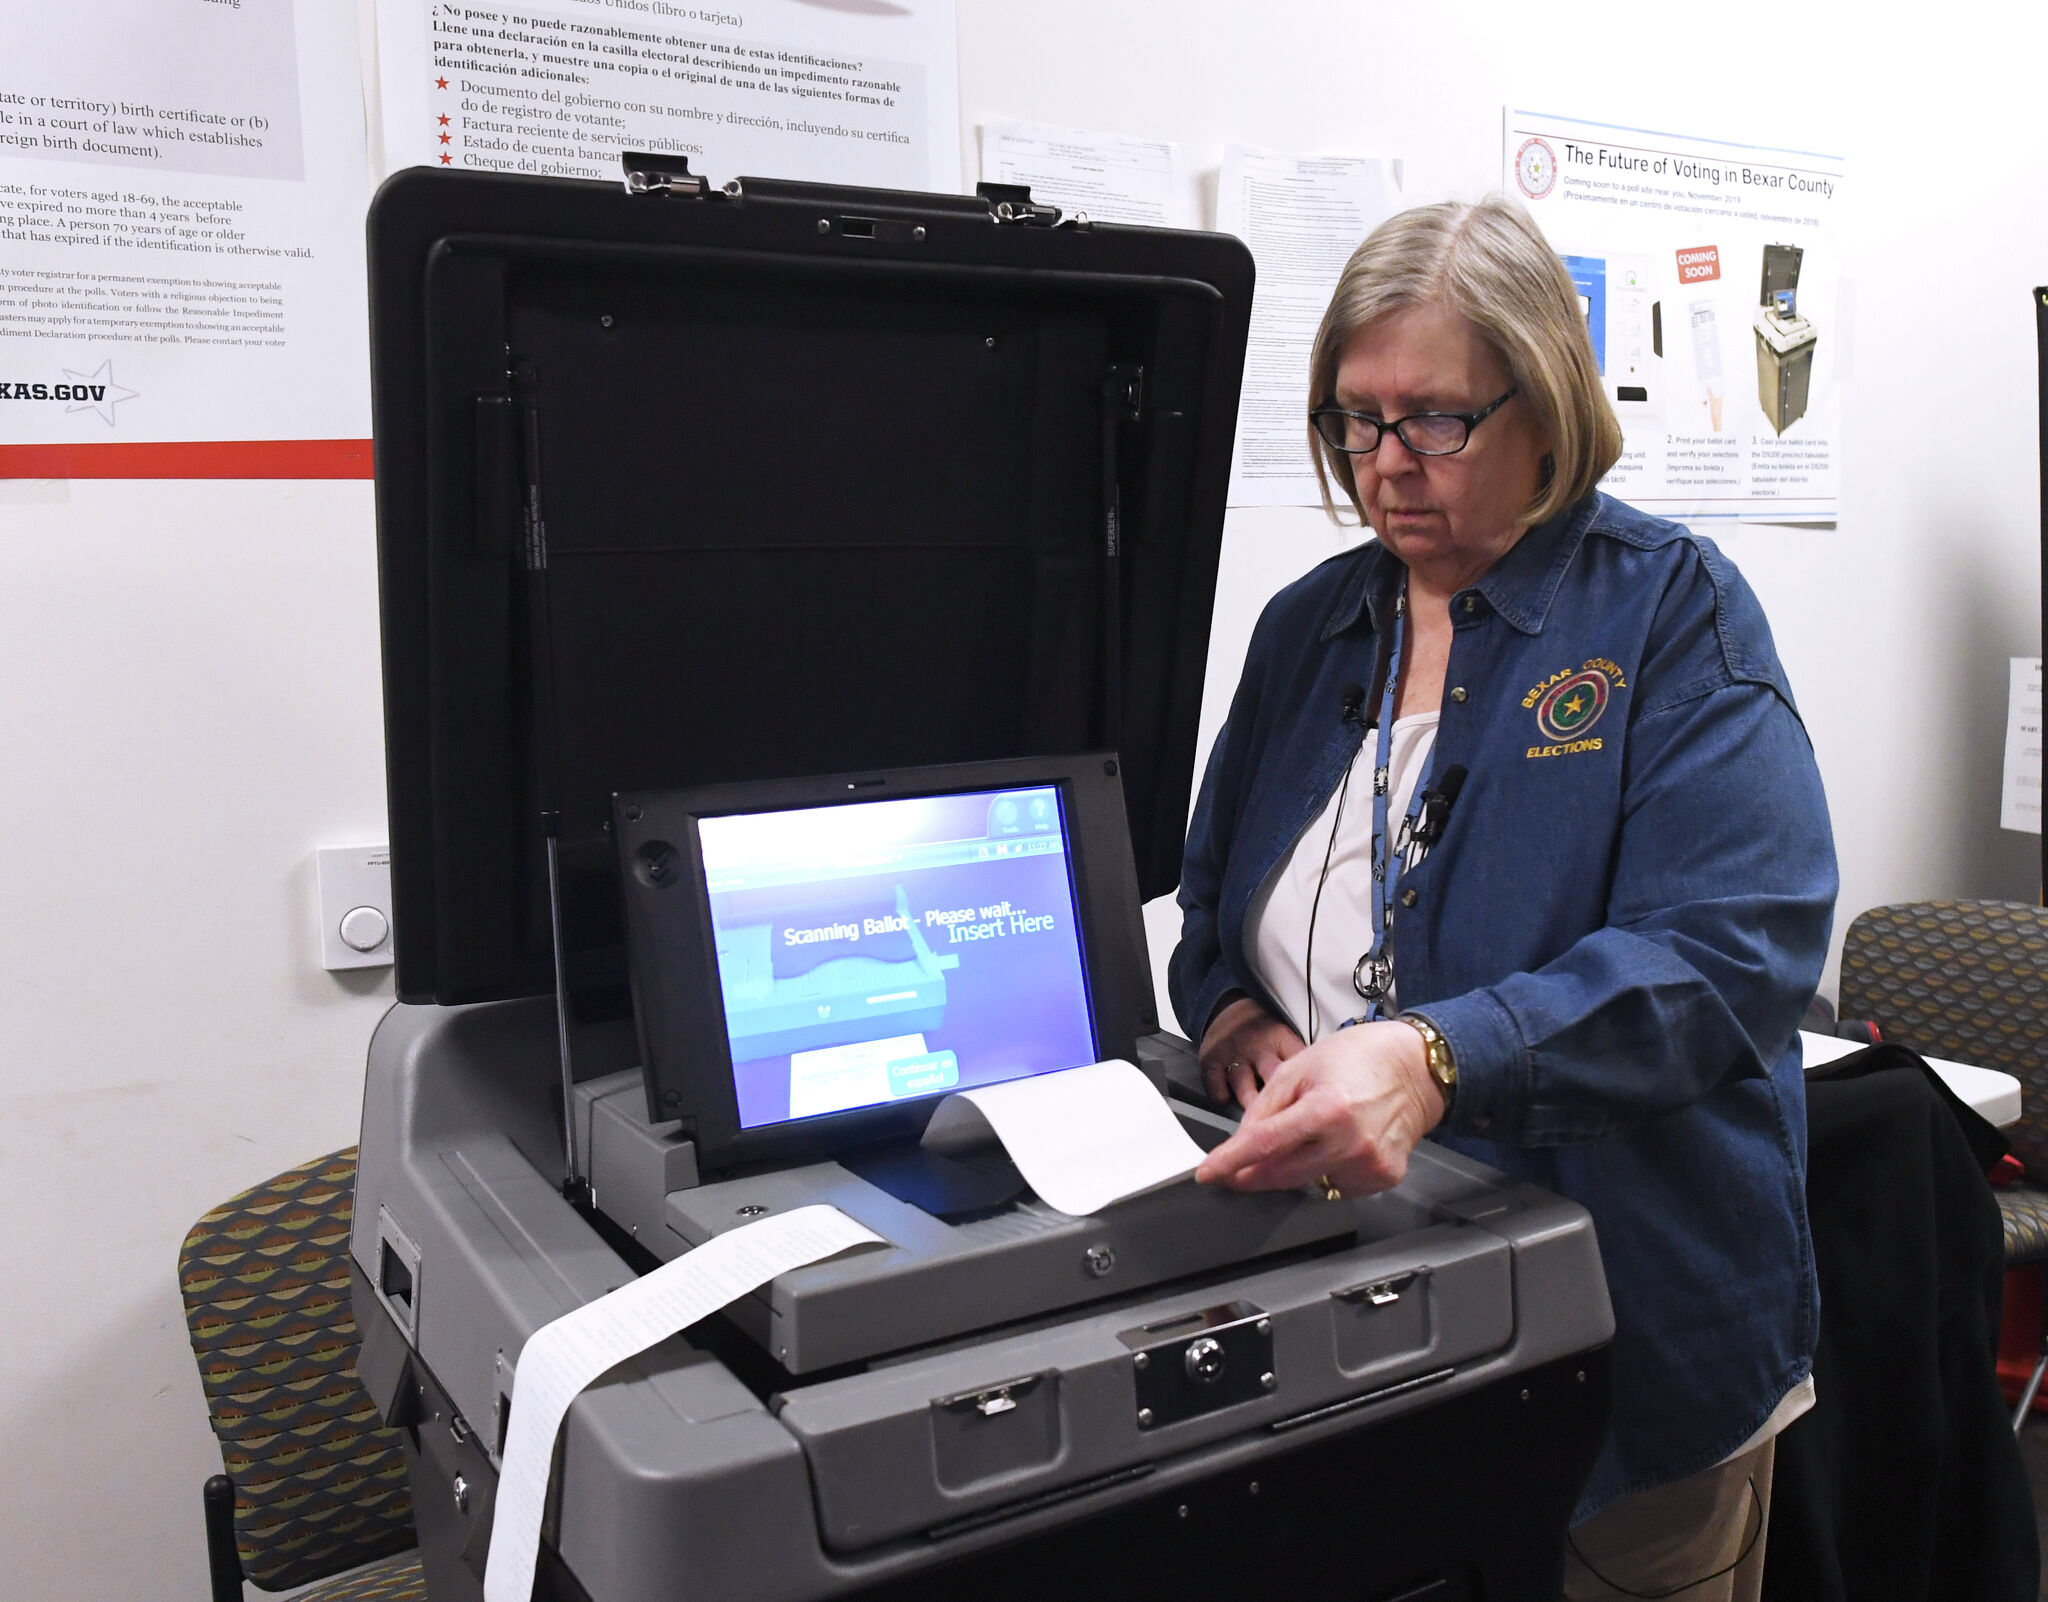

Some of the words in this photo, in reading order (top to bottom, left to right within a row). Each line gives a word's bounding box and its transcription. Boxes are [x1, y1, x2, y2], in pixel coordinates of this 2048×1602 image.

[652, 1, 686, 18] (libro
[689, 10, 697, 19] o
[700, 10, 743, 28] tarjeta)
[443, 4, 461, 16] No
[464, 9, 498, 21] posee
[501, 14, 508, 25] y
[513, 16, 527, 25] no
[531, 18, 567, 31] puede
[570, 24, 662, 44] razonablemente
[665, 35, 707, 50] obtener
[710, 44, 730, 54] una
[733, 45, 746, 56] de
[749, 49, 775, 60] estas
[777, 50, 862, 71] identificaciones?
[433, 20, 468, 35] Llene
[471, 27, 494, 38] una
[498, 29, 567, 47] declaración
[571, 41, 585, 50] en
[588, 40, 599, 52] la
[602, 44, 638, 57] casilla
[641, 48, 689, 64] electoral
[692, 55, 761, 74] describiendo
[763, 67, 777, 76] un
[780, 67, 849, 85] impedimento
[851, 79, 901, 92] razonable
[434, 57, 517, 75] identificación
[521, 67, 589, 84] adicionales:
[30, 96, 46, 107] or
[50, 97, 116, 116] territory)
[120, 101, 154, 118] birth
[158, 108, 226, 125] certificate
[230, 117, 245, 127] or
[248, 115, 269, 131] (b)
[460, 79, 538, 100] Documento
[541, 89, 561, 103] del
[564, 92, 621, 110] gobierno
[623, 102, 646, 113] con
[649, 105, 663, 115] su
[666, 106, 714, 121] nombre
[716, 113, 723, 125] y
[726, 111, 783, 131] dirección,
[786, 118, 848, 137] incluyendo
[850, 129, 863, 138] su
[866, 130, 909, 144] certifica
[0, 110, 13, 124] le
[18, 115, 33, 126] in
[37, 117, 46, 127] a
[50, 118, 88, 131] court
[92, 119, 110, 133] of
[112, 120, 138, 135] law
[142, 125, 184, 140] which
[188, 131, 262, 147] establishes
[462, 116, 513, 133] Factura
[516, 125, 569, 140] reciente
[572, 127, 588, 141] de
[590, 133, 645, 147] servicios
[648, 137, 703, 155] públicos;
[0, 131, 38, 149] reign
[42, 134, 78, 150] birth
[82, 139, 162, 160] document).
[463, 134, 509, 151] Estado
[512, 139, 528, 153] de
[531, 145, 575, 158] cuenta
[463, 153, 514, 170] Cheque
[517, 157, 536, 171] del
[540, 161, 601, 177] gobierno;
[1564, 144, 1593, 165] The
[1598, 149, 1648, 172] Future
[1653, 157, 1668, 174] of
[1673, 159, 1720, 185] Voting
[1725, 166, 1738, 183] in
[1742, 168, 1784, 187] Bexar
[1788, 174, 1833, 199] County
[29, 185, 47, 196] for
[50, 188, 88, 199] voters
[91, 191, 119, 203] aged
[122, 193, 159, 206] 18-69,
[161, 195, 180, 207] the
[183, 200, 242, 211] acceptable
[16, 201, 63, 213] expired
[67, 205, 82, 214] no
[85, 207, 116, 216] more
[119, 208, 146, 219] than
[149, 211, 156, 222] 4
[159, 212, 190, 223] years
[195, 213, 231, 225] before
[17, 216, 53, 227] place.
[56, 219, 66, 228] A
[69, 220, 110, 231] person
[112, 223, 128, 233] 70
[130, 225, 162, 235] years
[164, 227, 175, 235] of
[178, 228, 198, 239] age
[200, 230, 213, 238] or
[215, 229, 245, 240] older
[1, 229, 27, 240] that
[29, 231, 51, 242] has
[54, 234, 100, 246] expired
[103, 236, 111, 246] if
[114, 237, 133, 247] the
[136, 239, 212, 253] identification
[215, 245, 224, 253] is
[226, 245, 281, 256] otherwise
[283, 248, 314, 258] valid.
[1679, 251, 1716, 265] COMING
[1685, 265, 1713, 278] SOON
[1521, 669, 1572, 709] BEXAR
[1582, 658, 1627, 688] COUNTY
[1526, 738, 1603, 758] ELECTIONS
[784, 922, 860, 946] Scanning
[863, 914, 910, 935] Ballot
[925, 908, 976, 927] Please
[979, 901, 1027, 919] wait...
[947, 918, 1006, 944] Insert
[1010, 914, 1055, 935] Here
